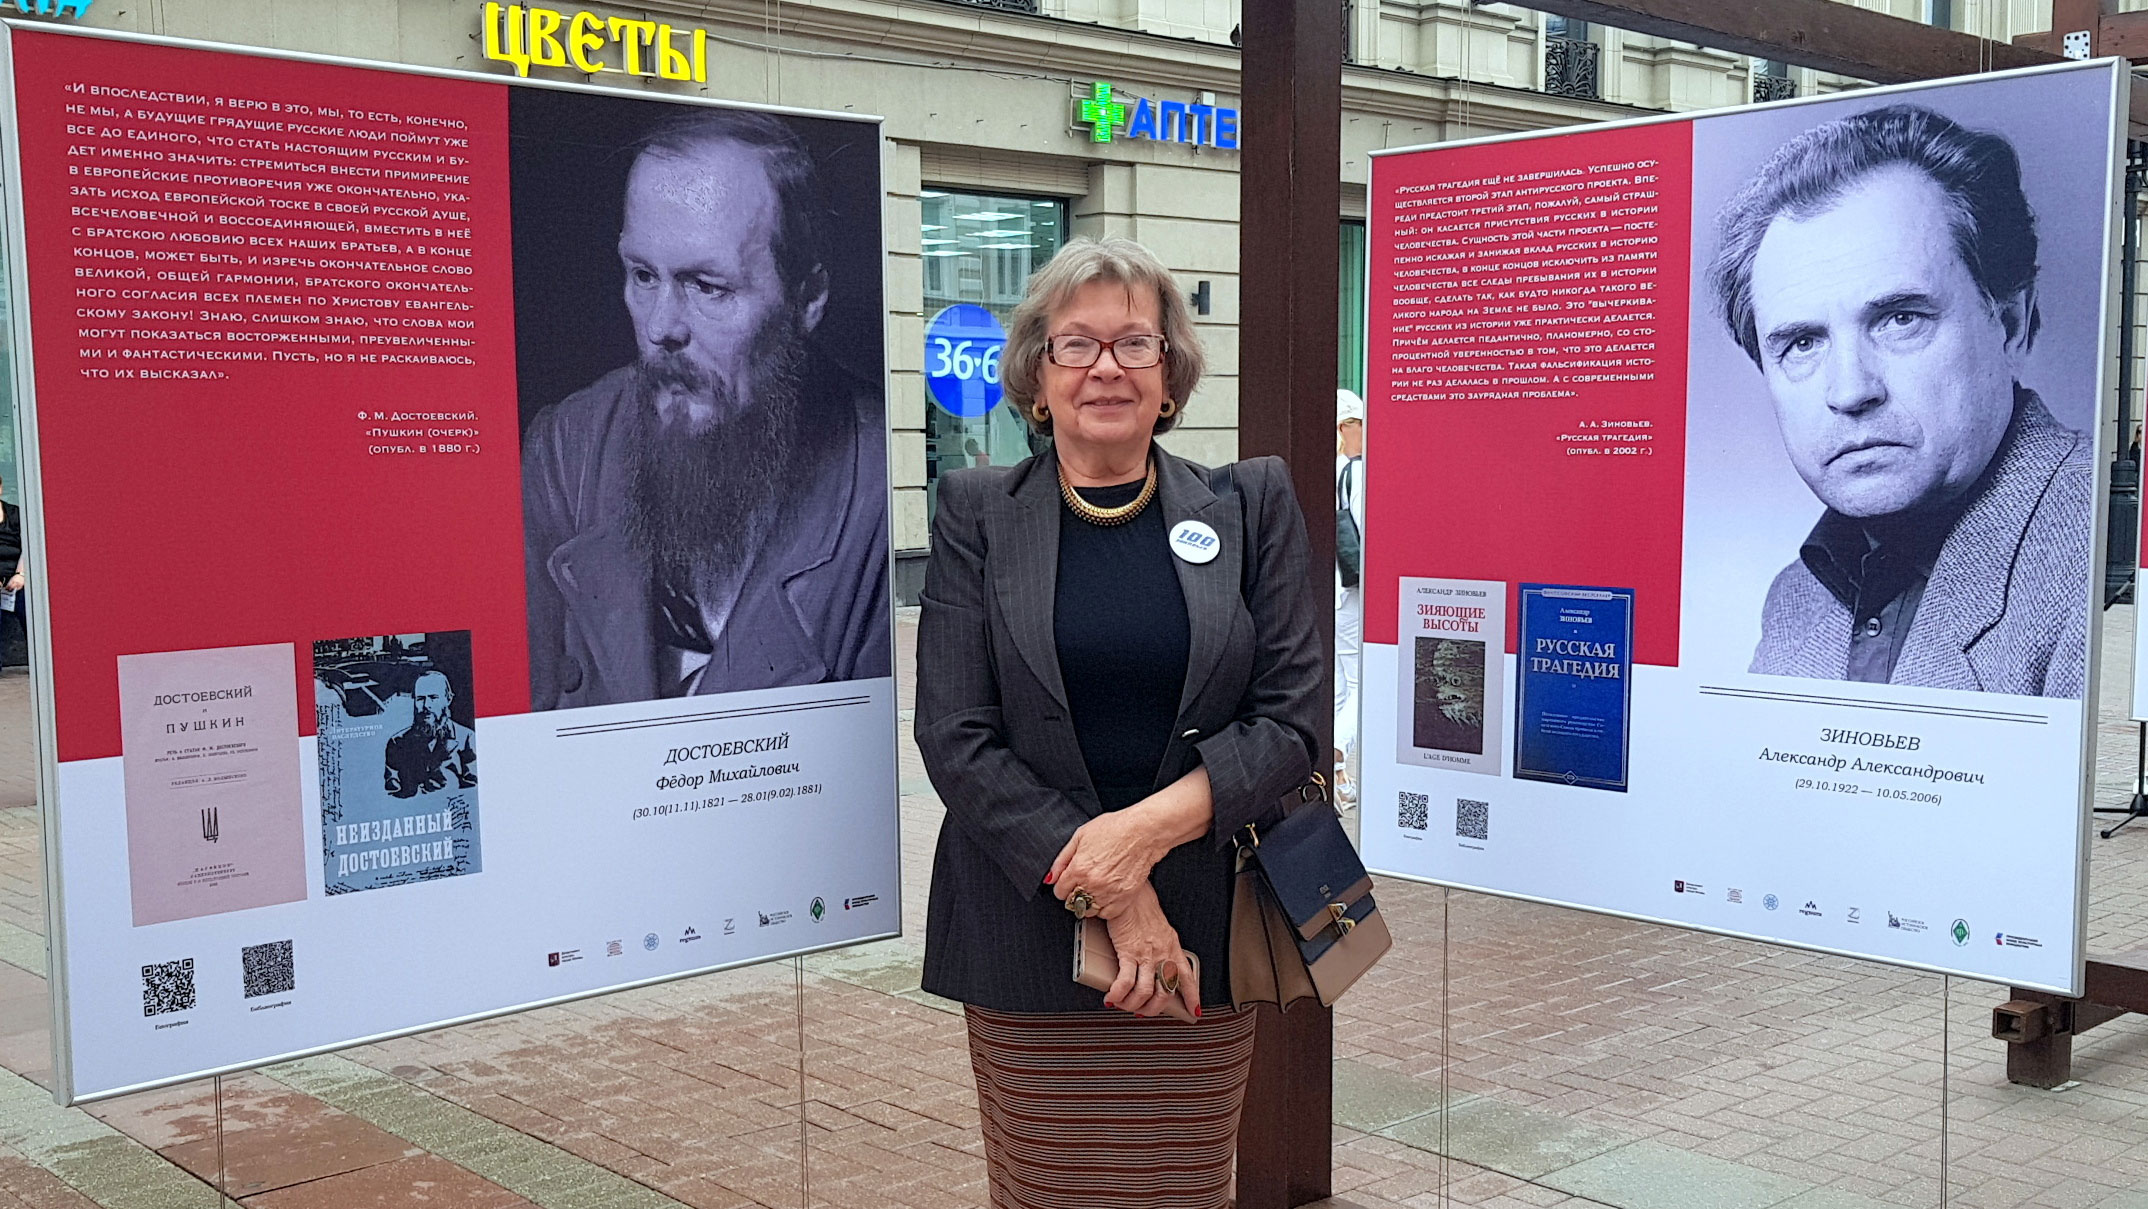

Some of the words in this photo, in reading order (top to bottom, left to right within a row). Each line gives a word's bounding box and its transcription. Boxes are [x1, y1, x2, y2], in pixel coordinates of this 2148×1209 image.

[485, 2, 707, 83] ЦВЕТЫ
[64, 82, 85, 94] «И
[90, 85, 210, 107] ВПОСЛЕДСТВИИ,
[214, 97, 224, 107] Я
[228, 98, 268, 111] ВЕРЮ
[271, 102, 281, 112] В
[284, 103, 313, 117] ЭТО,
[317, 106, 344, 119] МЫ,
[347, 109, 365, 120] ТО
[368, 111, 402, 125] ЕСТЬ,
[406, 115, 468, 131] КОНЕЧНО,
[65, 103, 86, 115] НЕ
[90, 105, 120, 119] МЫ,
[123, 109, 134, 119] А
[137, 109, 206, 125] БУДУЩИЕ
[209, 116, 284, 132] ГРЯДУЩИЕ
[287, 123, 345, 137] РУССКИЕ
[347, 129, 387, 142] ЛЮДИ
[390, 131, 441, 145] ПОЙМУТ
[443, 137, 469, 148] УЖЕ
[66, 124, 96, 136] ВСЕ
[100, 127, 122, 139] ДО
[127, 129, 202, 146] ЕДИНОГО,
[206, 135, 234, 147] ЧТО
[237, 138, 280, 151] СТАТЬ
[284, 142, 369, 158] НАСТОЯЩИМ
[373, 149, 432, 163] РУССКИМ
[436, 155, 445, 164] И
[449, 156, 470, 166] БУ-
[67, 145, 97, 156] ДЕТ
[101, 147, 164, 161] ИМЕННО
[167, 152, 237, 167] ЗНАЧИТЬ:
[240, 158, 326, 174] СТРЕМИТЬСЯ
[330, 165, 381, 178] ВНЕСТИ
[384, 169, 470, 185] ПРИМИРЕНИЕ
[78, 328, 126, 339] МОГУТ
[130, 329, 222, 341] ПОКАЗАТЬСЯ
[226, 331, 355, 345] ВОСТОРЖЕННЫМИ,
[359, 335, 476, 347] ПРЕУВЕЛИЧЕННЫ-
[79, 348, 102, 358] МИ
[107, 349, 118, 358] И
[122, 348, 268, 361] ФАНТАСТИЧЕСКИМИ.
[272, 350, 320, 363] ПУСТЬ,
[324, 353, 343, 362] НО
[347, 353, 356, 363] Я
[359, 354, 378, 363] НЕ
[381, 354, 476, 366] РАСКАИВАЮСЬ,
[80, 368, 110, 379] ЧТО
[114, 369, 135, 379] ИХ
[139, 369, 230, 380] ВЫСКАЗАЛ».
[1179, 529, 1216, 547] 100
[1416, 603, 1487, 622] ЗИЯЮЩИЕ
[1423, 617, 1480, 633] ВЫСОТЫ
[1536, 638, 1616, 659] РУССКАЯ
[1530, 656, 1621, 680] ТРАГЕДИЯ
[153, 685, 253, 706] ДОСТОЕВСКИЙ
[166, 716, 245, 734] ПУШКИН
[663, 732, 790, 766] ДОСТОЕВСКИЙ
[1819, 728, 1921, 751] ЗИНОВЬЕВ
[656, 774, 704, 790] Фёдор
[708, 762, 800, 784] Михайлович
[1758, 747, 1847, 772] Александр
[1850, 757, 1985, 785] Александрович
[1795, 778, 1859, 795] (29.10.1922
[1876, 787, 1943, 806] 10.05.2006)
[336, 808, 453, 846] НЕИЗДАННЫЙ
[338, 838, 454, 878] ДОСТОЕВСКИЙ
